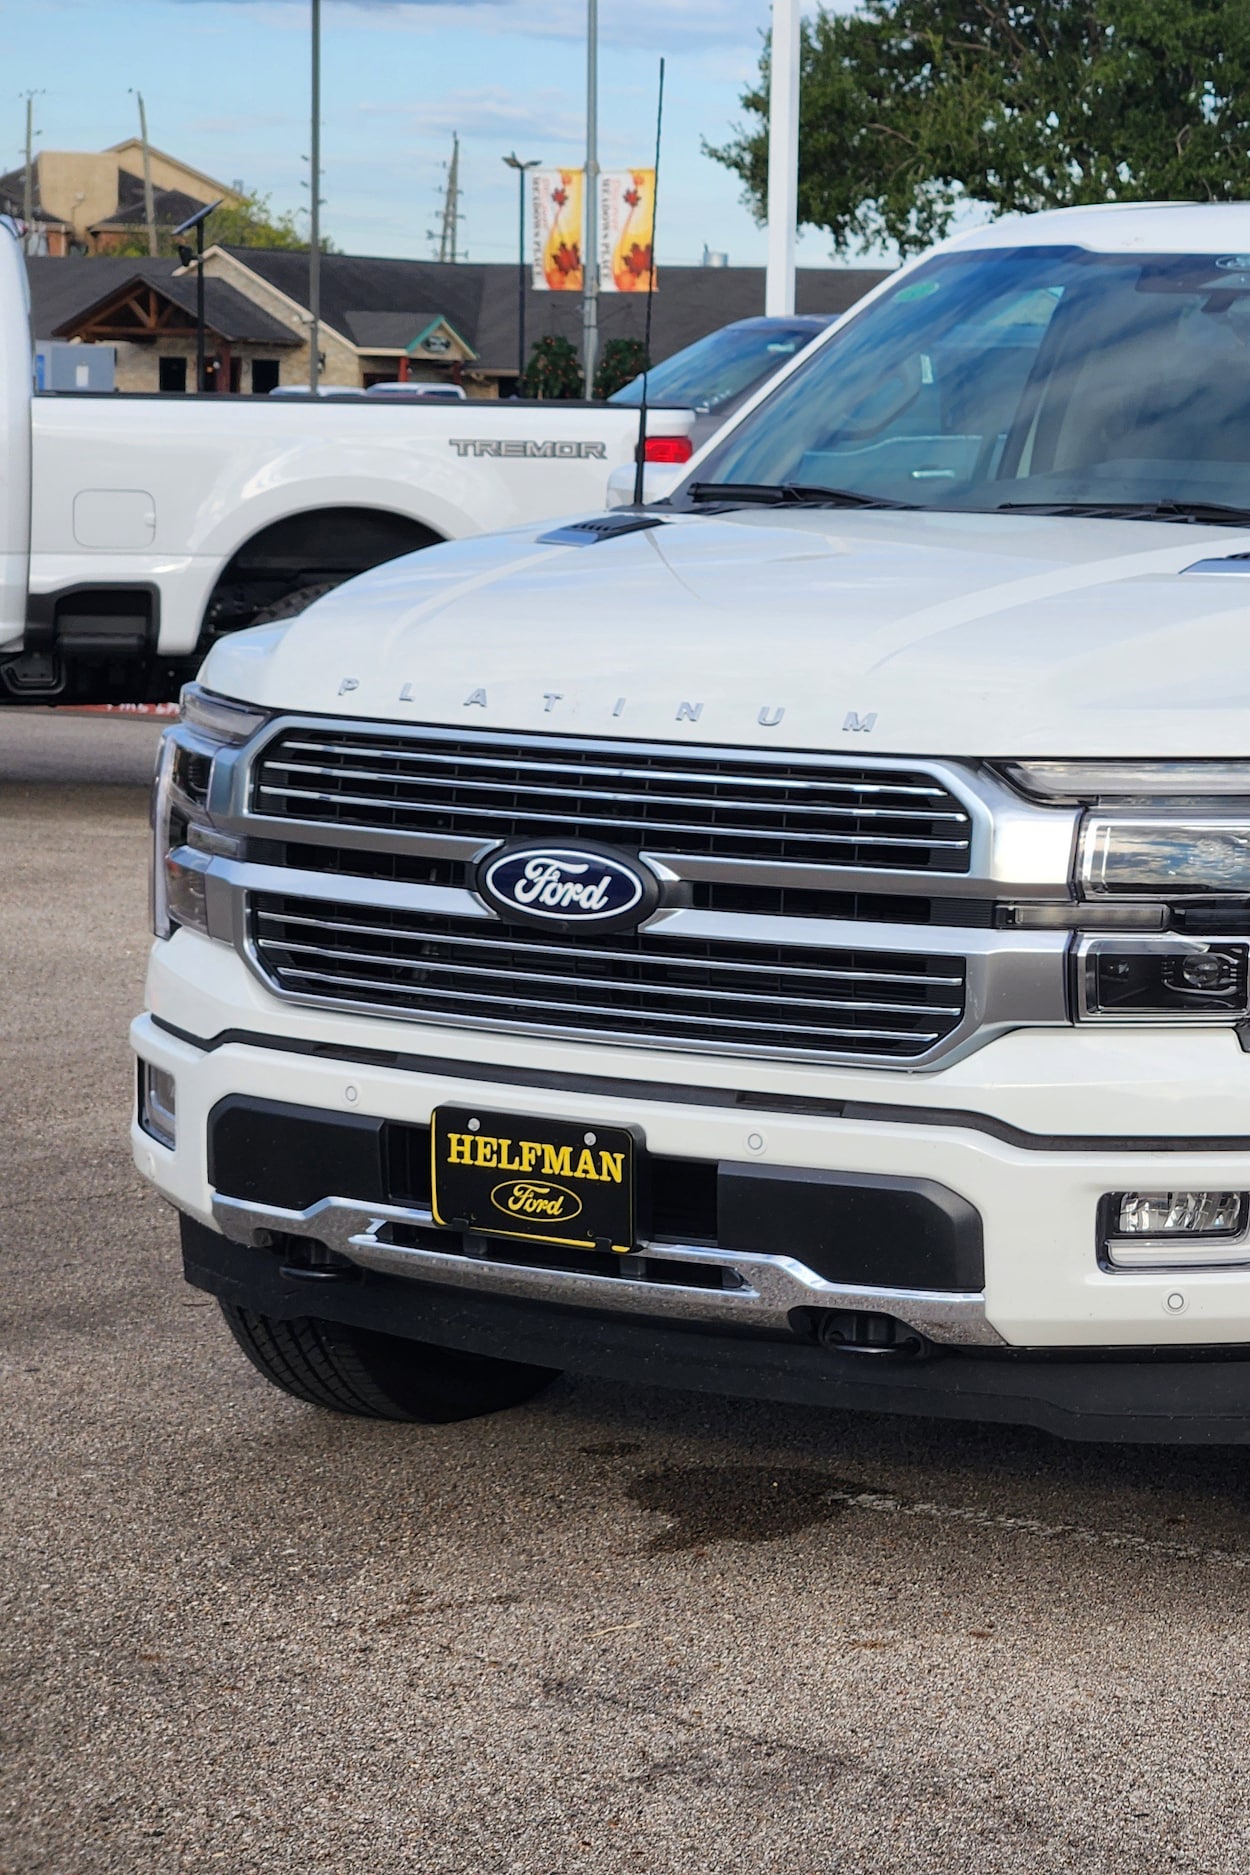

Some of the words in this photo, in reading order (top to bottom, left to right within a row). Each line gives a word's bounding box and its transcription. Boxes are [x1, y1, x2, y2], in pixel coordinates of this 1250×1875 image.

[449, 439, 608, 460] TREMOR
[338, 677, 877, 732] PLATINUM
[514, 857, 612, 911] Ford
[447, 1133, 625, 1183] HELFMAN
[508, 1183, 565, 1216] Ford
